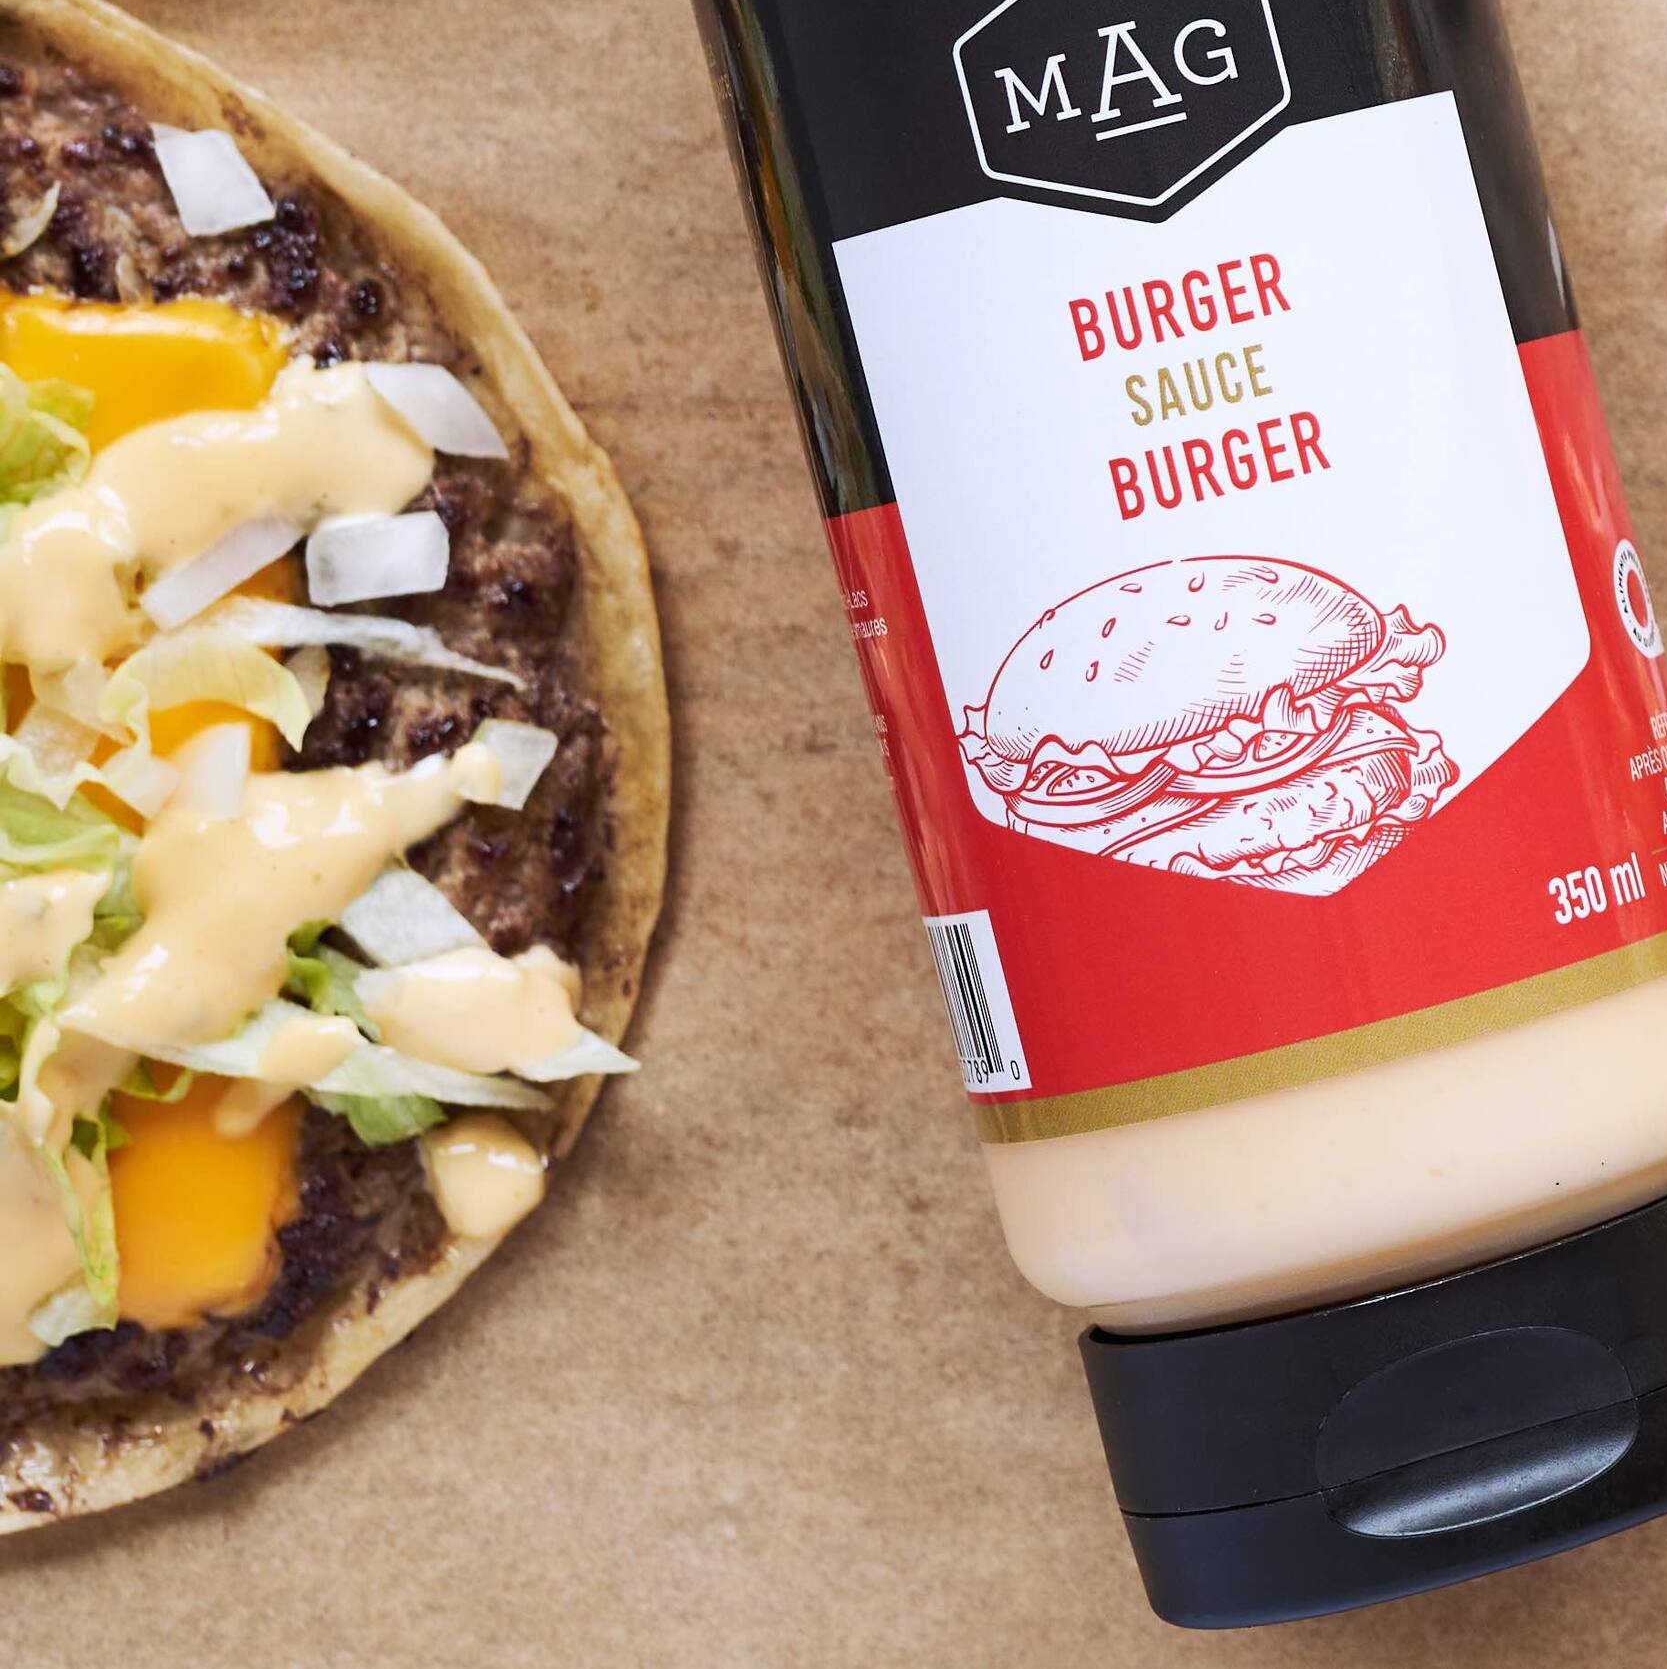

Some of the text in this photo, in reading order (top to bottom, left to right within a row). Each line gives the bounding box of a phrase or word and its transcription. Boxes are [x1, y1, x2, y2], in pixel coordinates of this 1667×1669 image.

[994, 19, 1239, 134] MAG
[1069, 253, 1291, 361] BURGER
[1125, 344, 1273, 426] SAUCE
[1109, 411, 1331, 520] BURGER
[1629, 745, 1663, 781] APRÈS
[1548, 851, 1646, 925] 350 ml
[1010, 1060, 1021, 1081] 0
